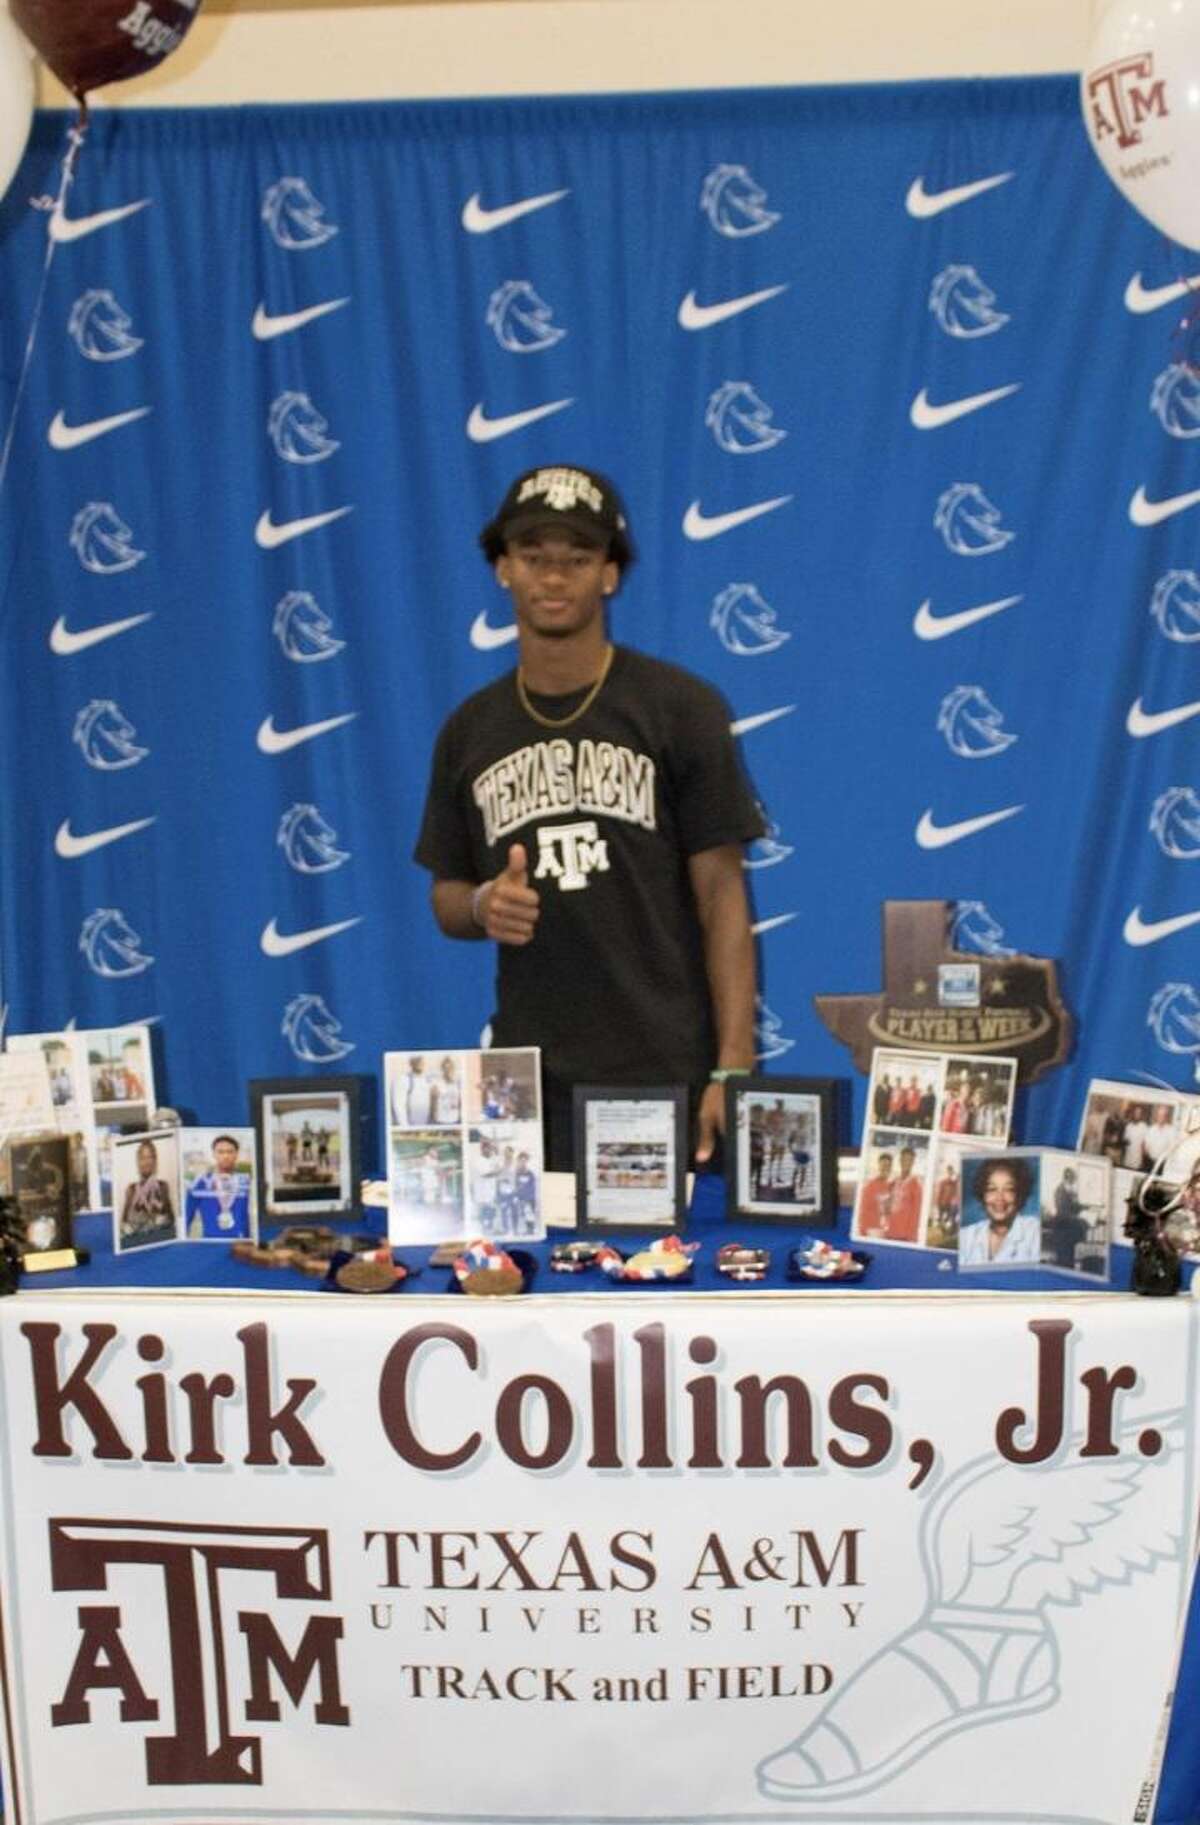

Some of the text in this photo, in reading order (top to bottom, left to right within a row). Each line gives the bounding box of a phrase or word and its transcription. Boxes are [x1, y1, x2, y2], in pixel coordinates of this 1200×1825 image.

[472, 738, 656, 847] TEXAS A&M
[887, 1017, 959, 1041] PLAYER
[978, 1016, 1032, 1040] WEEK
[20, 1319, 1163, 1491] Kirk Collins, Jr.
[363, 1528, 867, 1593] TEXAS A&M
[369, 1602, 865, 1635] UNIVERSITY
[402, 1663, 834, 1703] TRACK and FIELD
